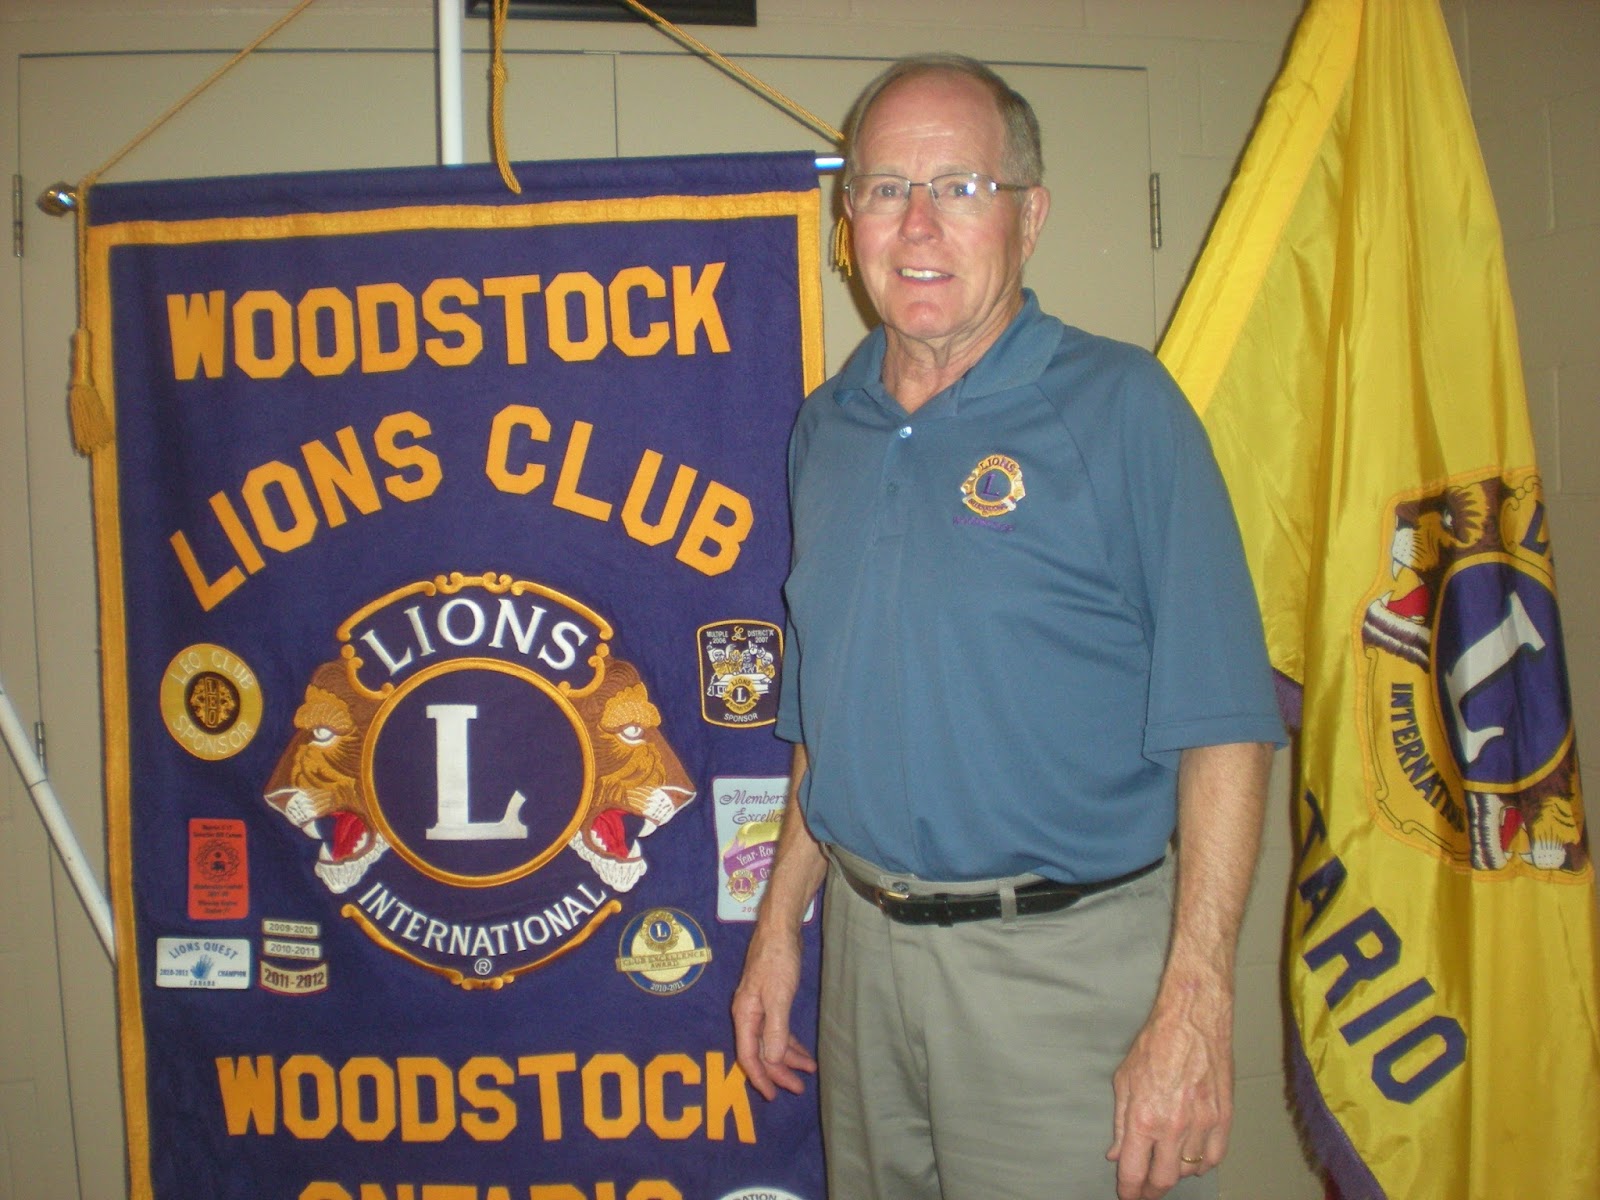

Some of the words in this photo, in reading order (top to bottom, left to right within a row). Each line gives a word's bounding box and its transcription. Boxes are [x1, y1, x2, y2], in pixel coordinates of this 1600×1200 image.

[167, 262, 731, 381] WOODSTOCK
[980, 457, 1016, 472] LIONS
[982, 473, 999, 497] L
[170, 411, 443, 612] LIONS
[485, 404, 755, 577] CLUB
[360, 598, 588, 677] LIONS
[707, 630, 728, 638] MULTIPLE
[747, 629, 768, 637] DISTRICT
[713, 637, 727, 645] 2006
[755, 636, 769, 644] 2007
[170, 651, 201, 685] LEO
[211, 651, 254, 690] CLUB
[1443, 591, 1547, 765] L
[736, 687, 746, 703] L
[724, 713, 758, 722] SPONSOR
[173, 715, 254, 755] SPONSOR
[425, 704, 527, 840] L
[719, 789, 788, 806] Members
[732, 807, 785, 825] Excelle
[269, 922, 314, 934] 2009-2010
[357, 882, 608, 957] INTERNATIONAL
[655, 923, 667, 938] L
[168, 942, 201, 960] LIONS
[203, 941, 239, 960] QUEST
[270, 943, 315, 956] 2010-2011
[623, 956, 646, 966] CLUB
[648, 952, 705, 963] EXCELLENCE
[650, 961, 680, 969] AWARD
[217, 970, 247, 978] CHAMPION
[264, 970, 325, 989] 2011-2012
[650, 980, 685, 992] 2010-2011
[215, 1052, 758, 1144] WOODSTOCK
